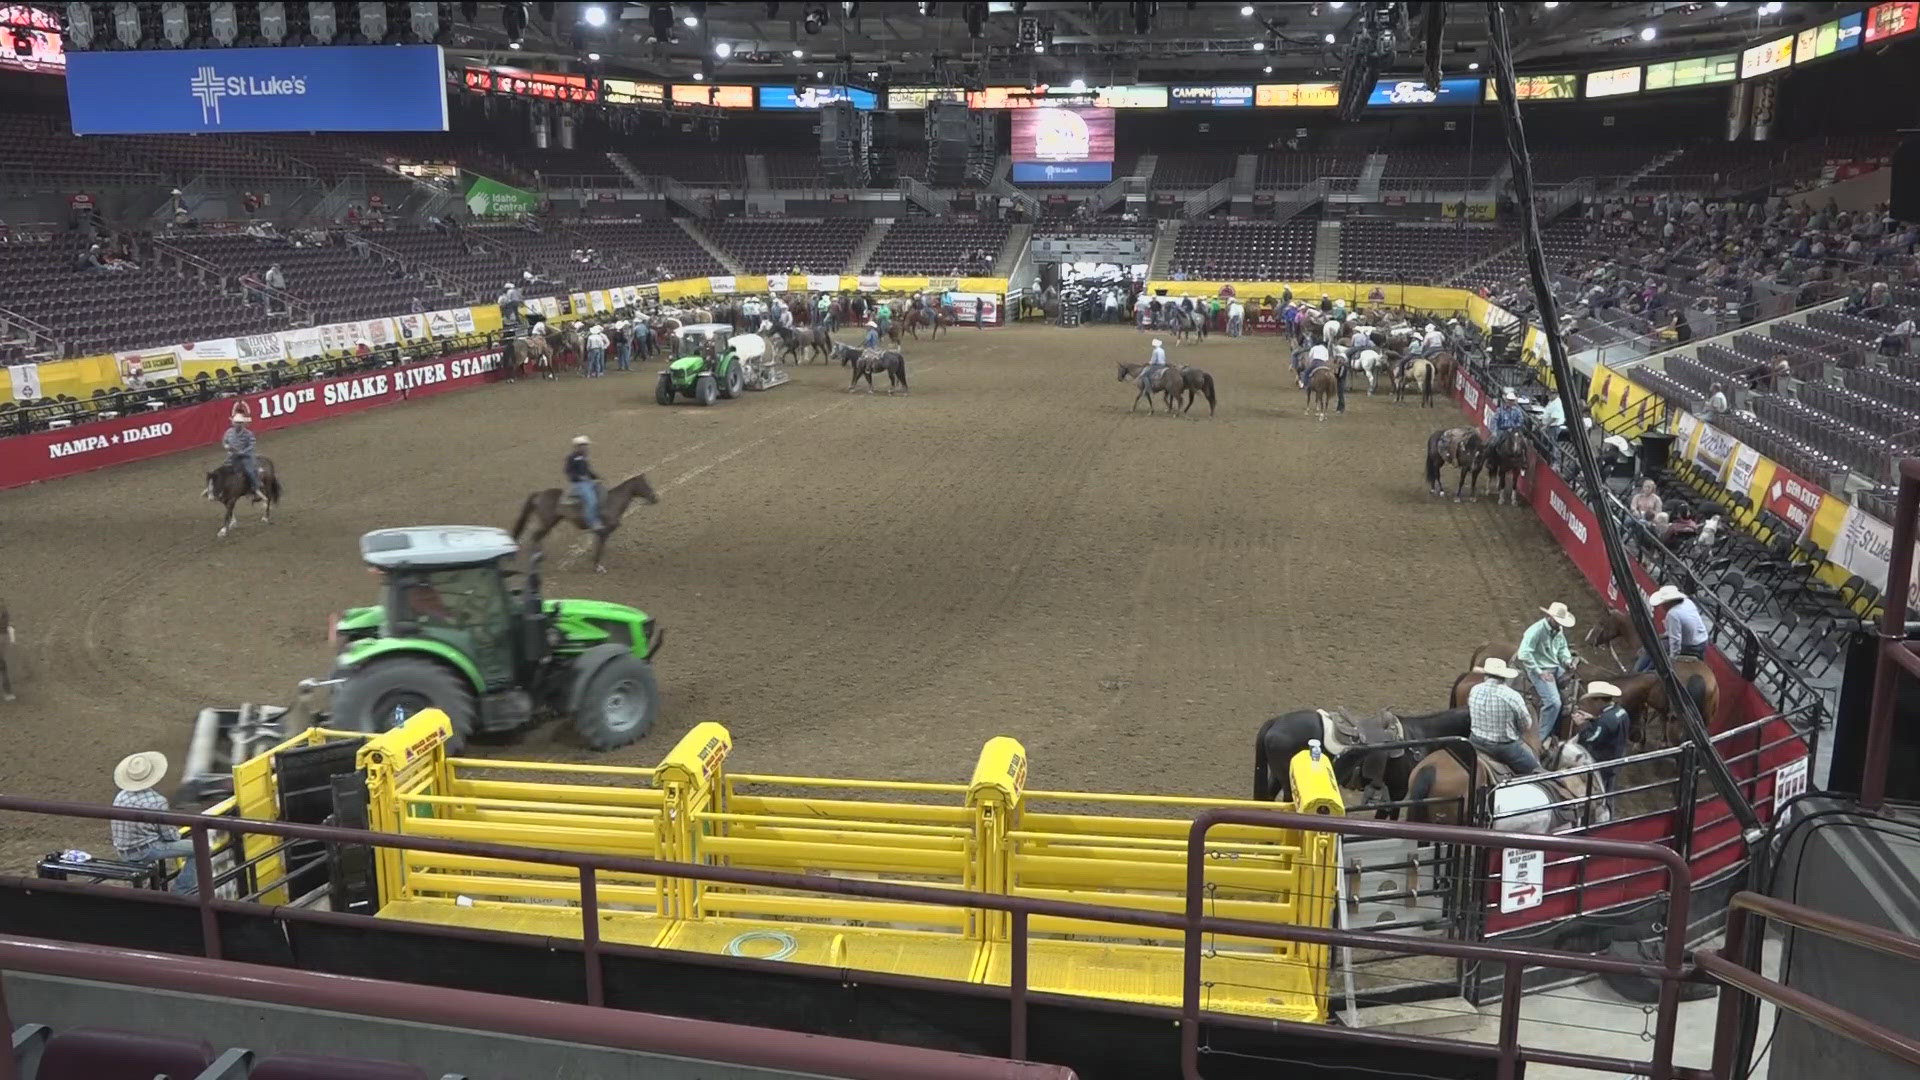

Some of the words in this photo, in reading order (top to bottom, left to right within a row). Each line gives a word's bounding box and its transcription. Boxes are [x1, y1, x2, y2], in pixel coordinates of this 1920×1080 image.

[227, 76, 247, 95] St
[250, 75, 306, 95] Luke's
[1217, 87, 1253, 98] WORLD
[1390, 82, 1437, 103] Ford
[492, 194, 517, 203] Idaho
[492, 203, 527, 212] Central
[248, 333, 278, 346] IDAHO
[258, 388, 316, 419] 110TH
[323, 375, 389, 406] SNAKE
[394, 363, 448, 391] RIVER
[451, 352, 504, 379] STAMP
[49, 434, 109, 459] NAMPA
[123, 422, 173, 444] IDAHO
[1859, 530, 1874, 550] St
[1869, 535, 1893, 563] Luke
[1509, 856, 1522, 865] KEEP
[1522, 853, 1537, 862] CLEAR
